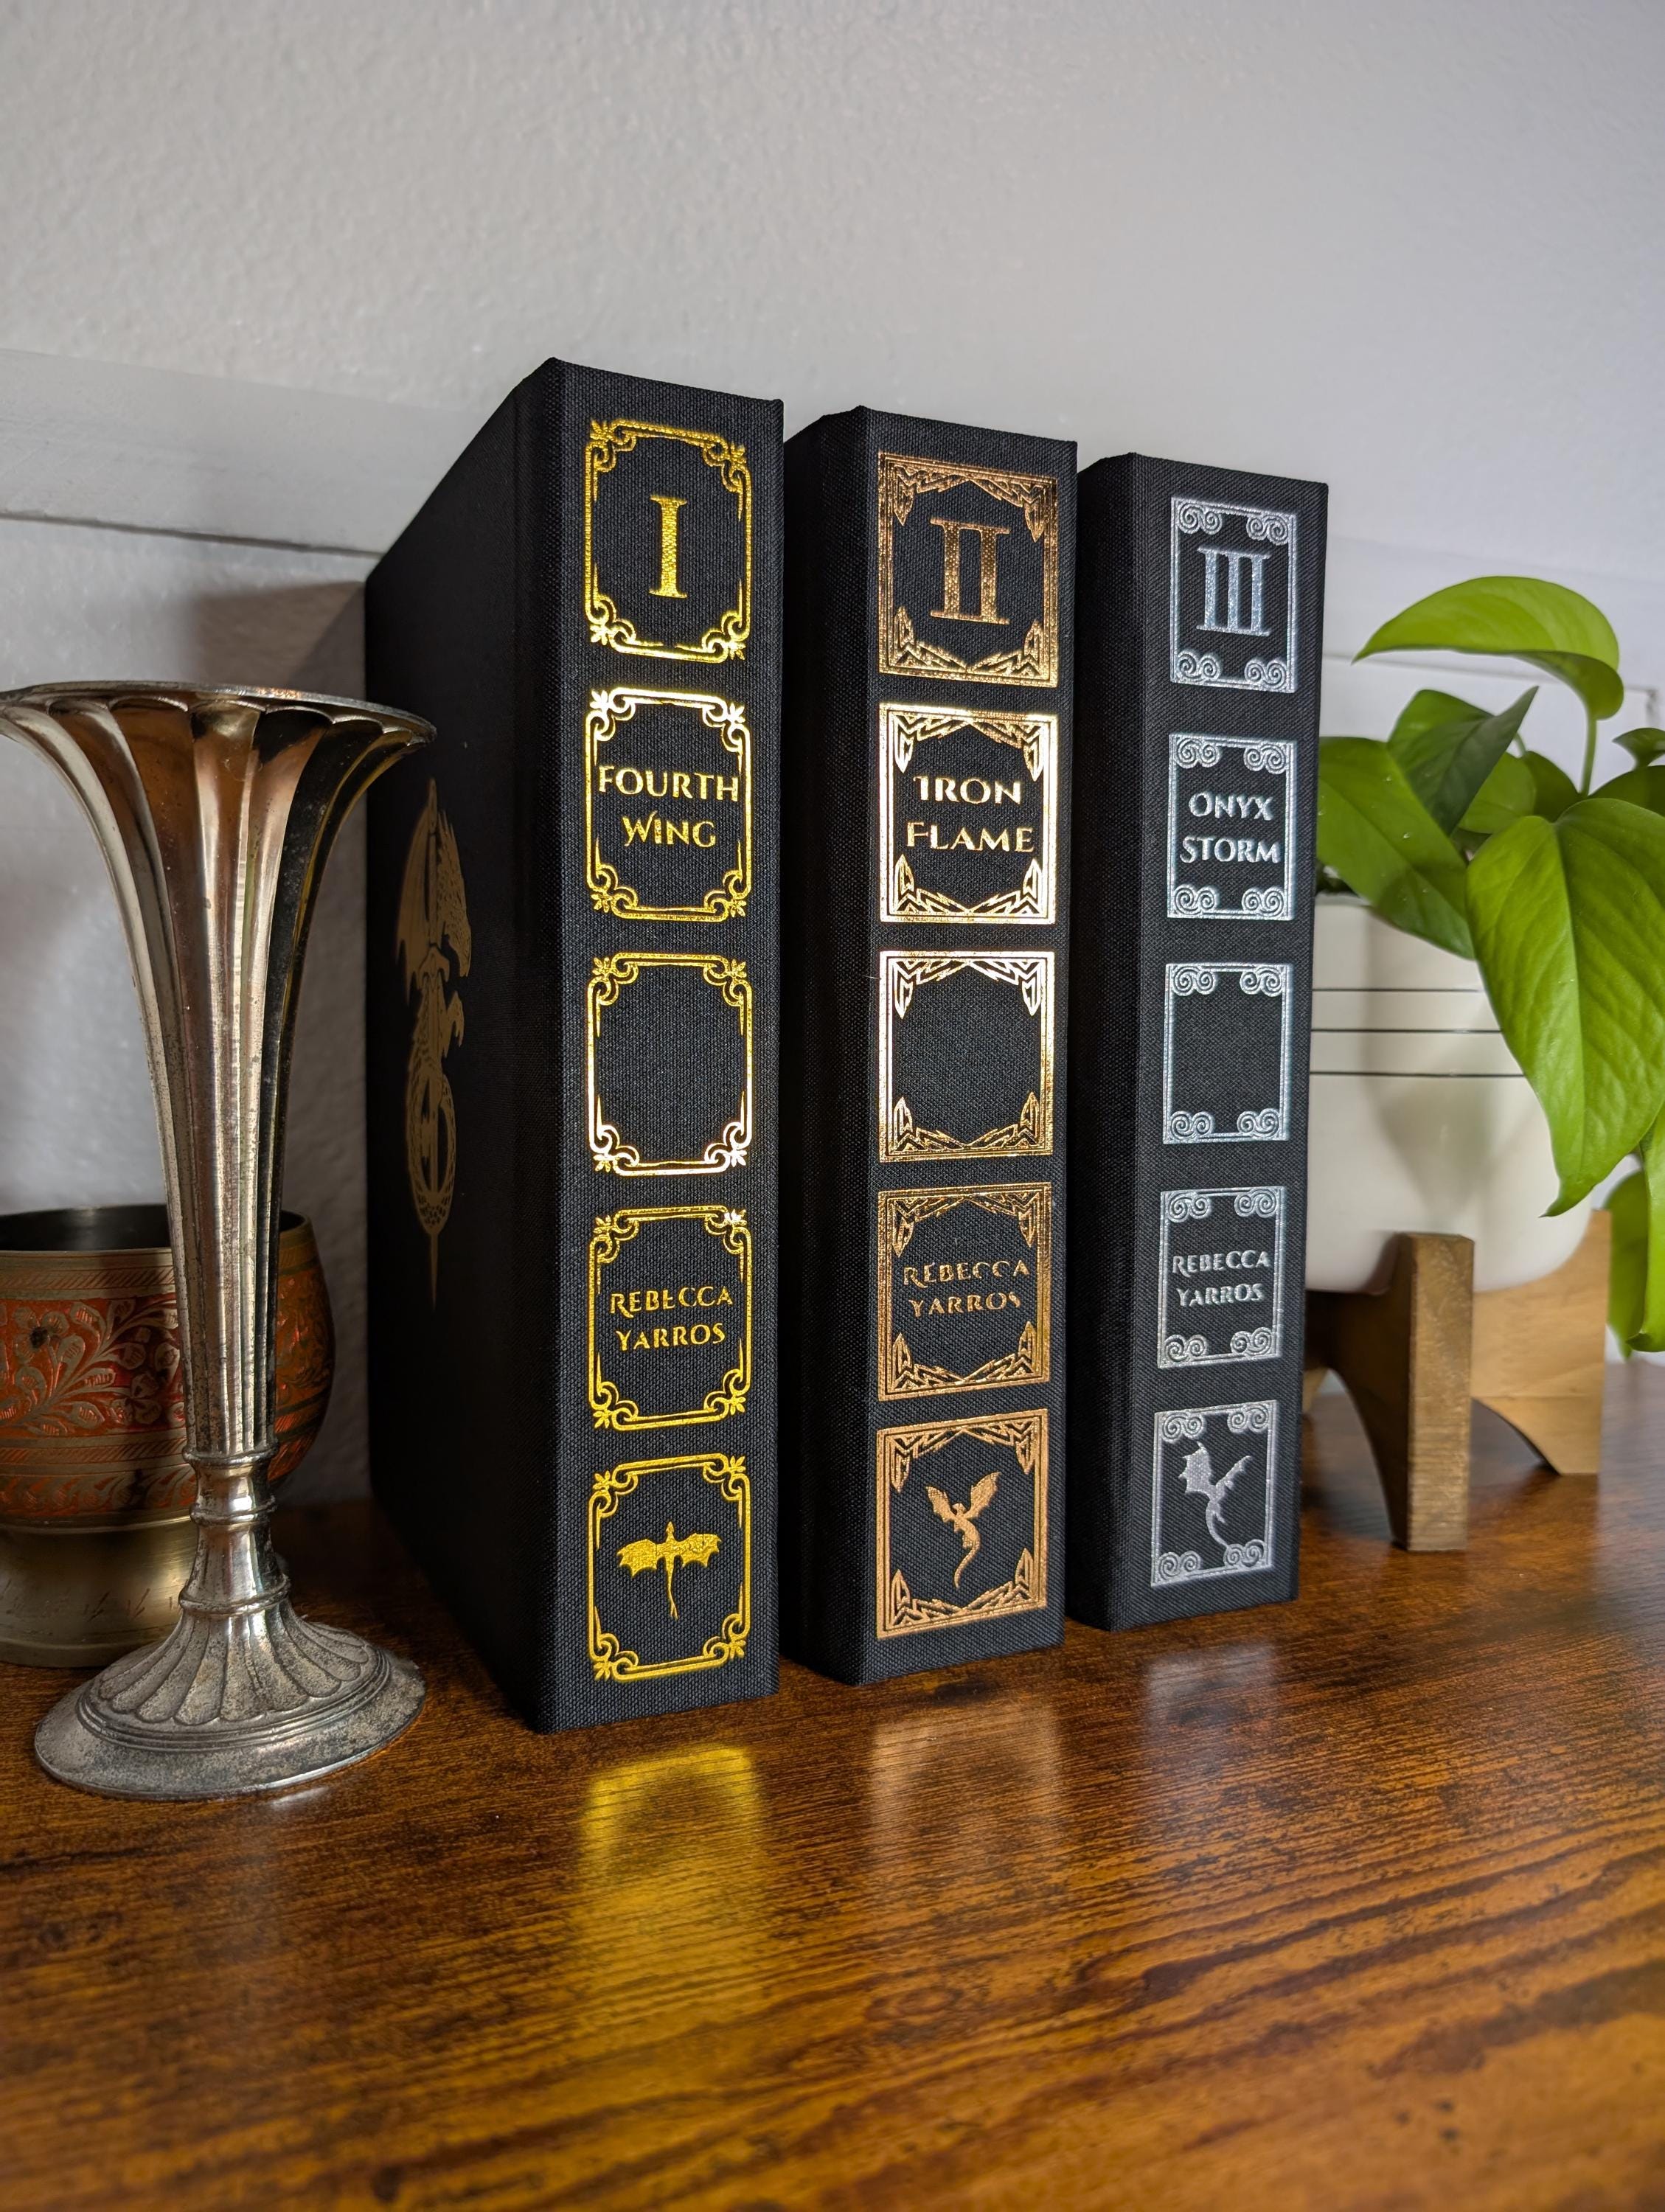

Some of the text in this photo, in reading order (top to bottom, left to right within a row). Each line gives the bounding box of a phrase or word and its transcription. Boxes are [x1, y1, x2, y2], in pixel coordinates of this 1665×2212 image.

[649, 495, 687, 598] I
[930, 517, 1009, 625] II
[1196, 547, 1268, 636] III
[598, 765, 739, 802] FOURTH
[917, 776, 1021, 805] IRON
[1188, 792, 1273, 821] ONYX
[622, 811, 716, 848] WING
[906, 822, 1035, 855] FLAME
[1180, 836, 1281, 863] STORM
[904, 1260, 1030, 1289] REBECCA
[1172, 1251, 1271, 1278] REBECCA
[611, 1286, 733, 1318] REBECCA
[908, 1292, 1021, 1318] YARROS
[1176, 1283, 1264, 1307] YARROS
[616, 1323, 726, 1352] YARROS
